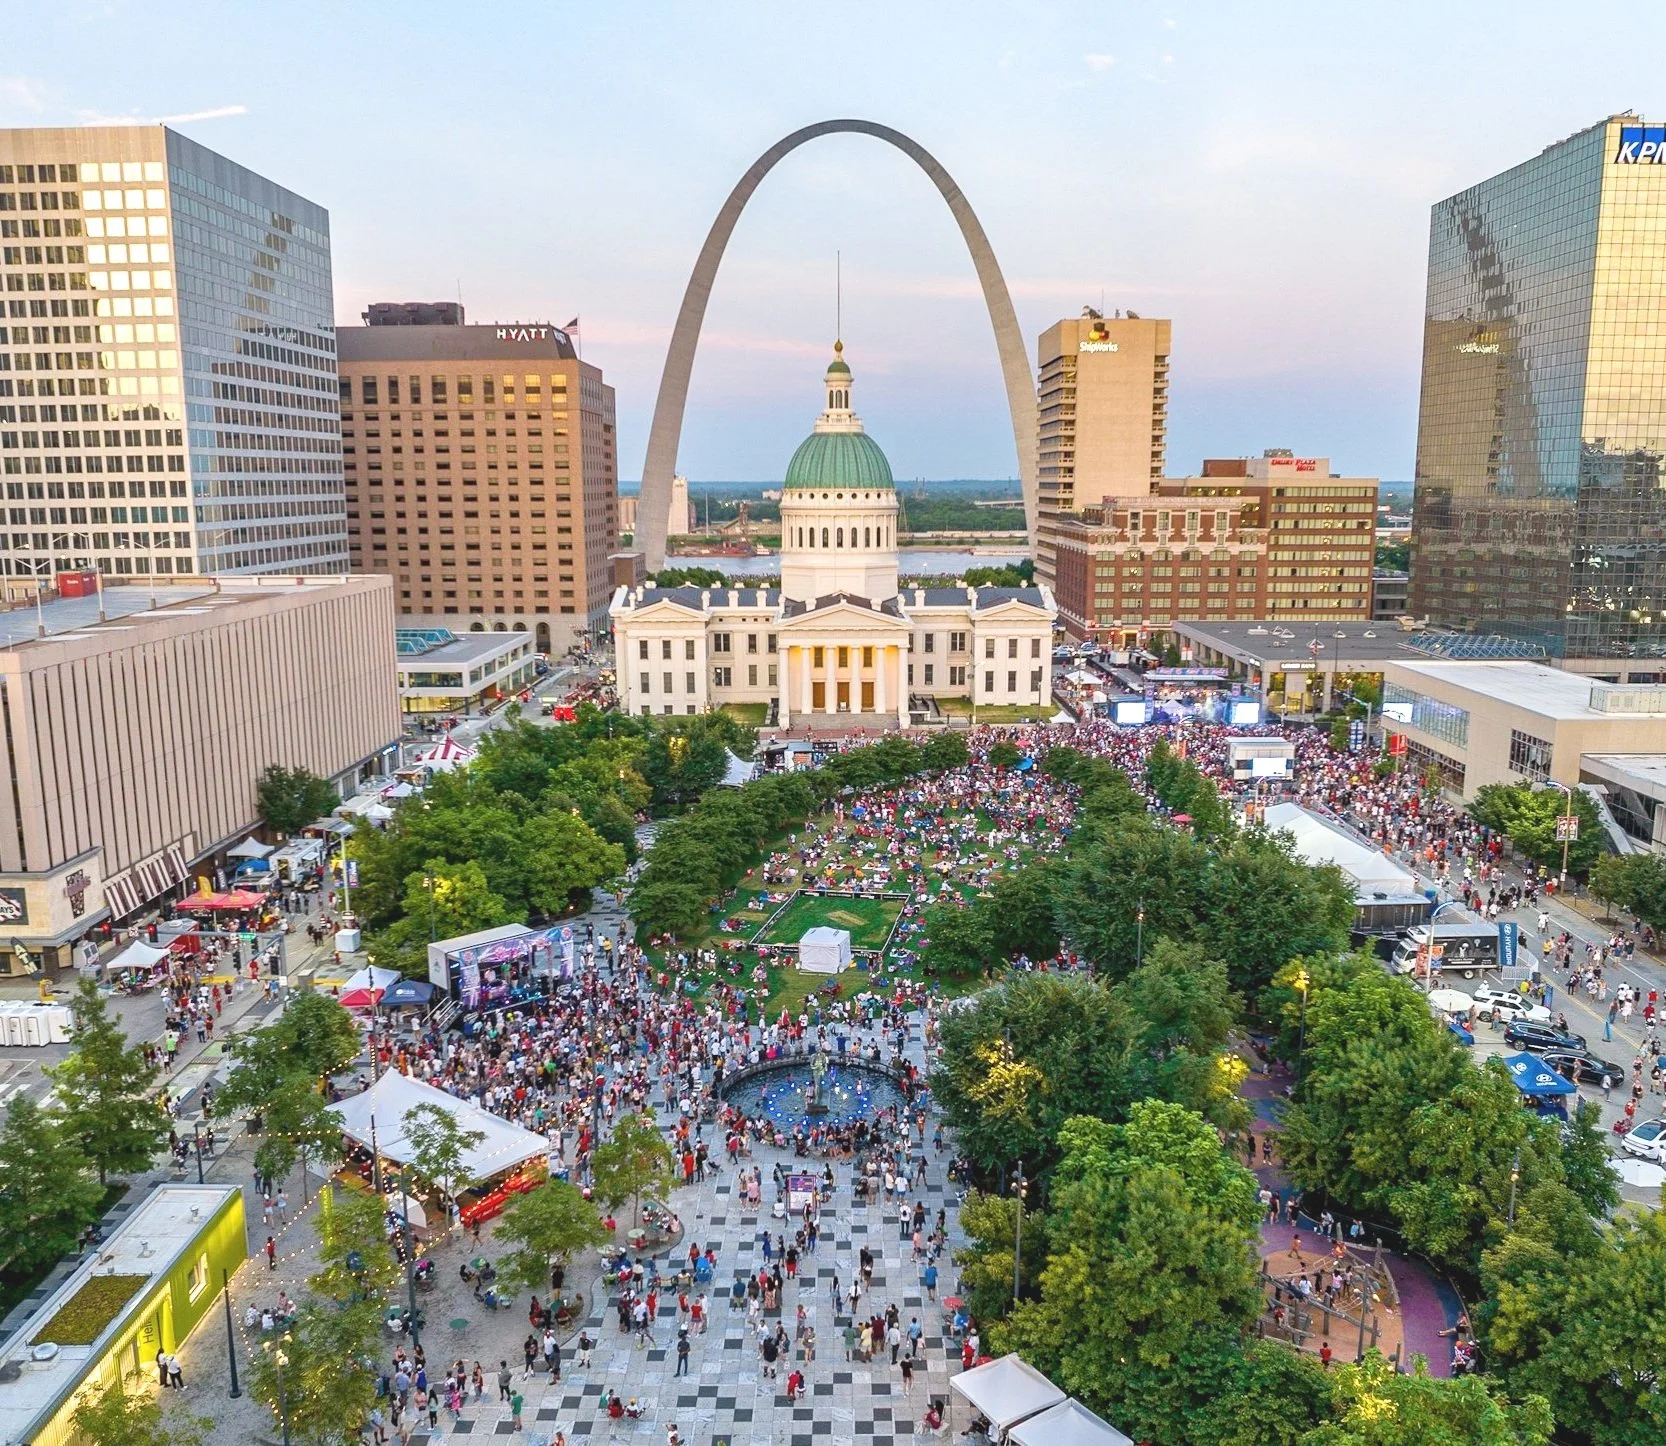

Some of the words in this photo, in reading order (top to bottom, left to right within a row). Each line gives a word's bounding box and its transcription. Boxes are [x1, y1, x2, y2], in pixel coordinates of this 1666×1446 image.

[496, 328, 548, 342] HYATT
[1079, 341, 1119, 354] ShipWorks
[14, 944, 38, 974] ATM
[1504, 936, 1513, 966] HYUNDAI
